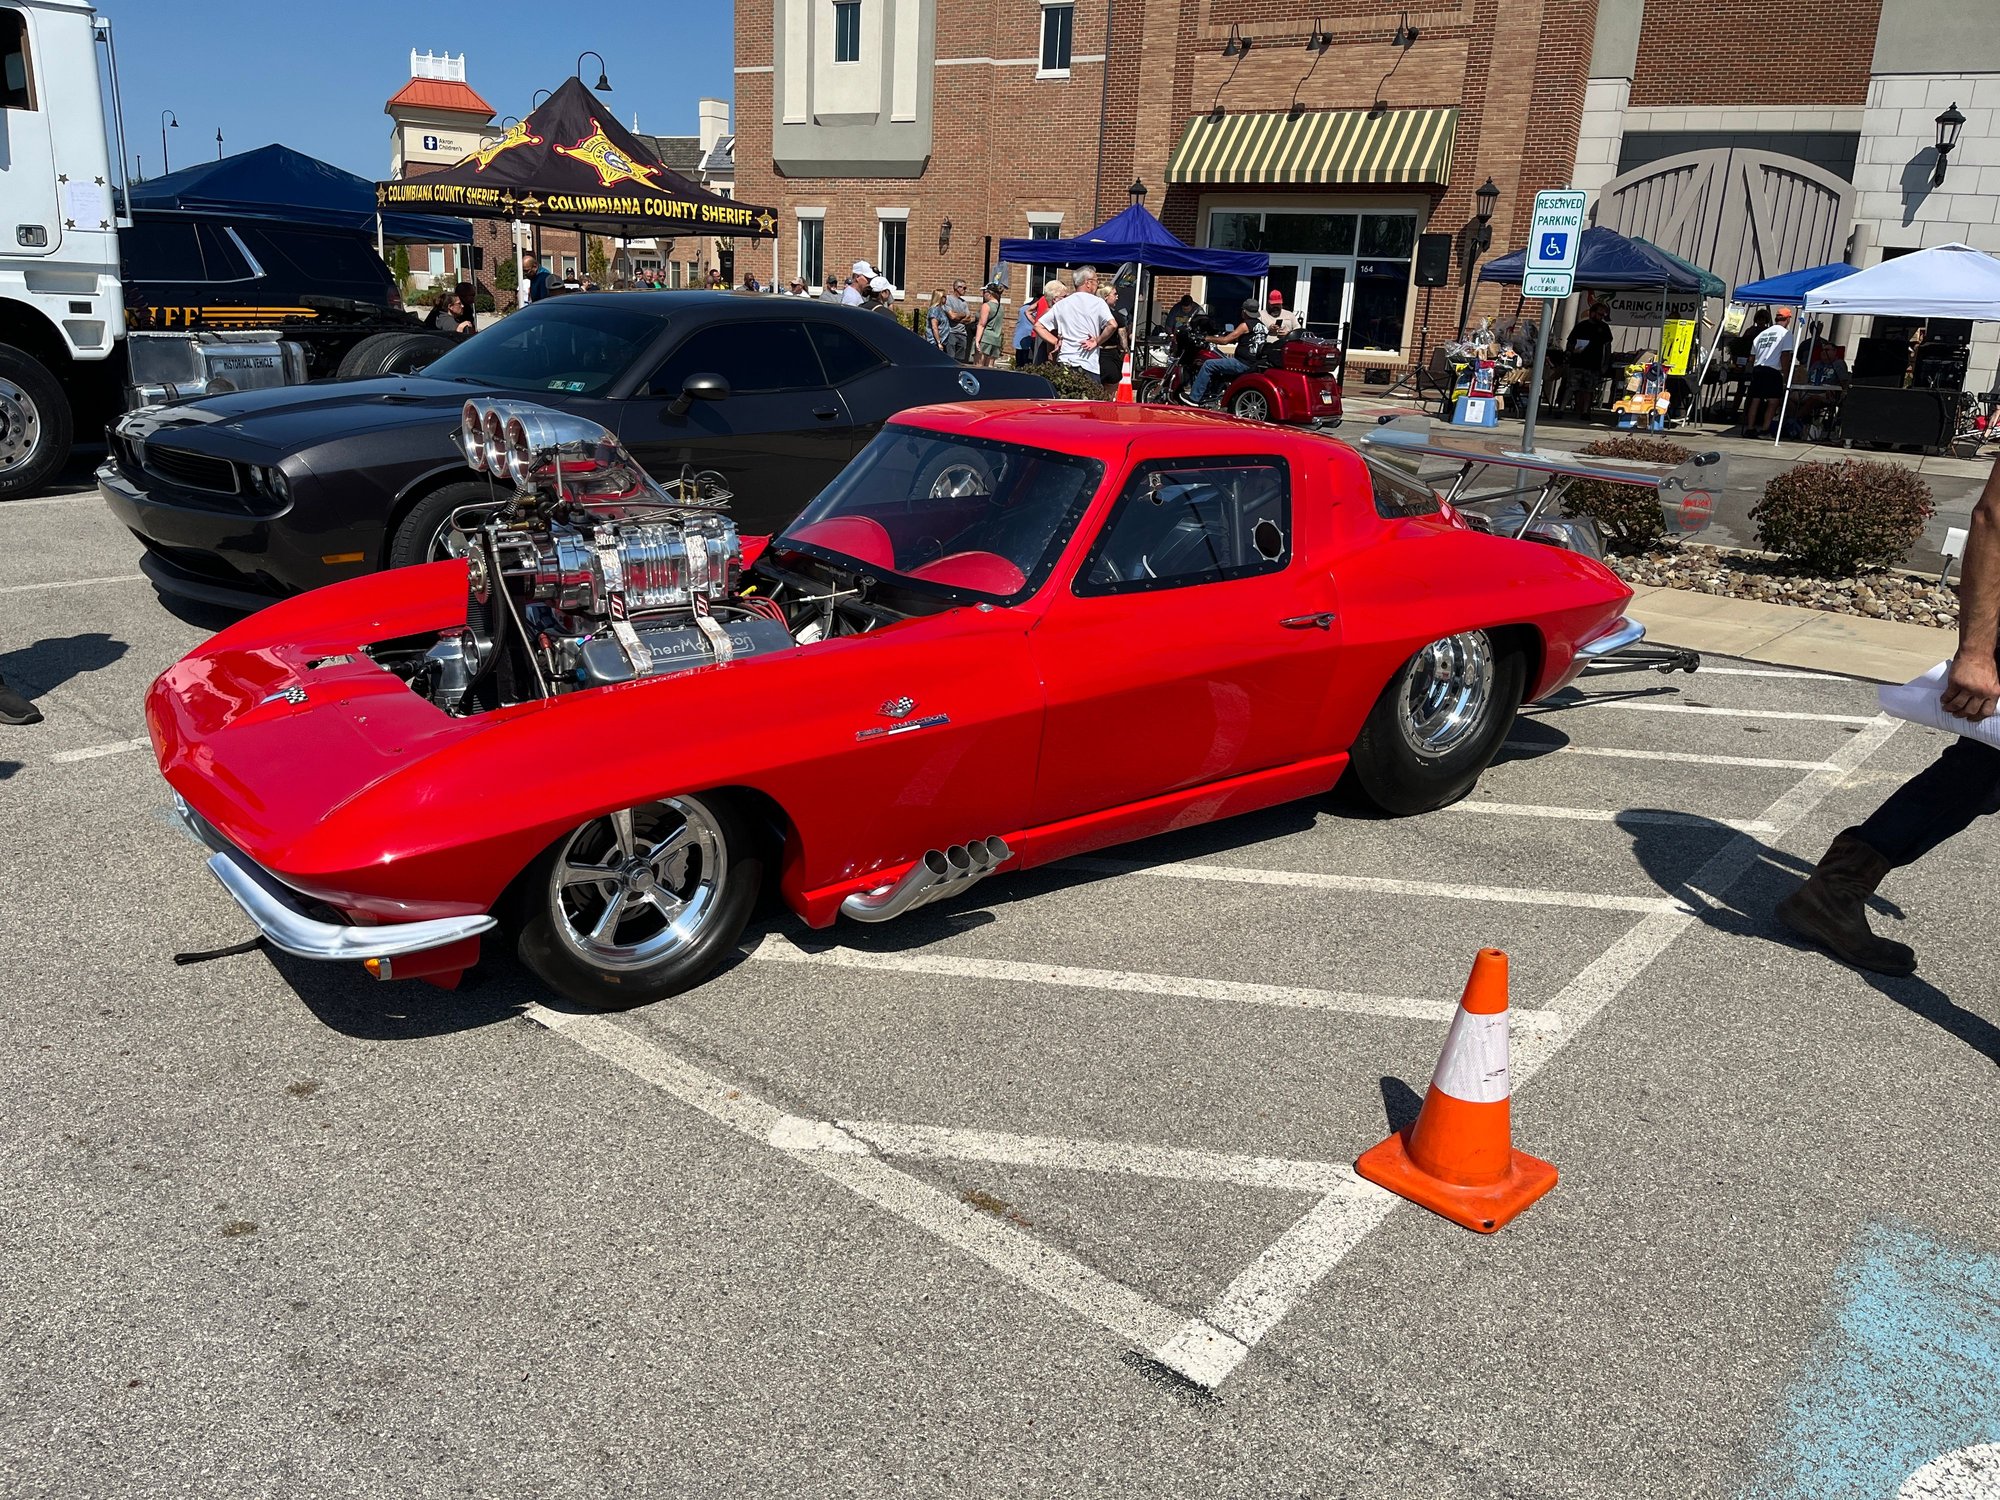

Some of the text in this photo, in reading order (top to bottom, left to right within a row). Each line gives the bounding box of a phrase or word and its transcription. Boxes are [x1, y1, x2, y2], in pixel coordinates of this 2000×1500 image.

[439, 144, 462, 152] Children's
[388, 184, 500, 207] COLUMBIANA COUNTY SHERIFF
[1538, 198, 1583, 209] RESERVED
[547, 195, 753, 226] COLUMBIANA COUNTY SHERIFF
[1537, 215, 1578, 226] PARKING
[1360, 265, 1374, 273] 164
[1611, 300, 1696, 313] CARING HANDS
[223, 357, 273, 369] HISTORICAL VEHICLE
